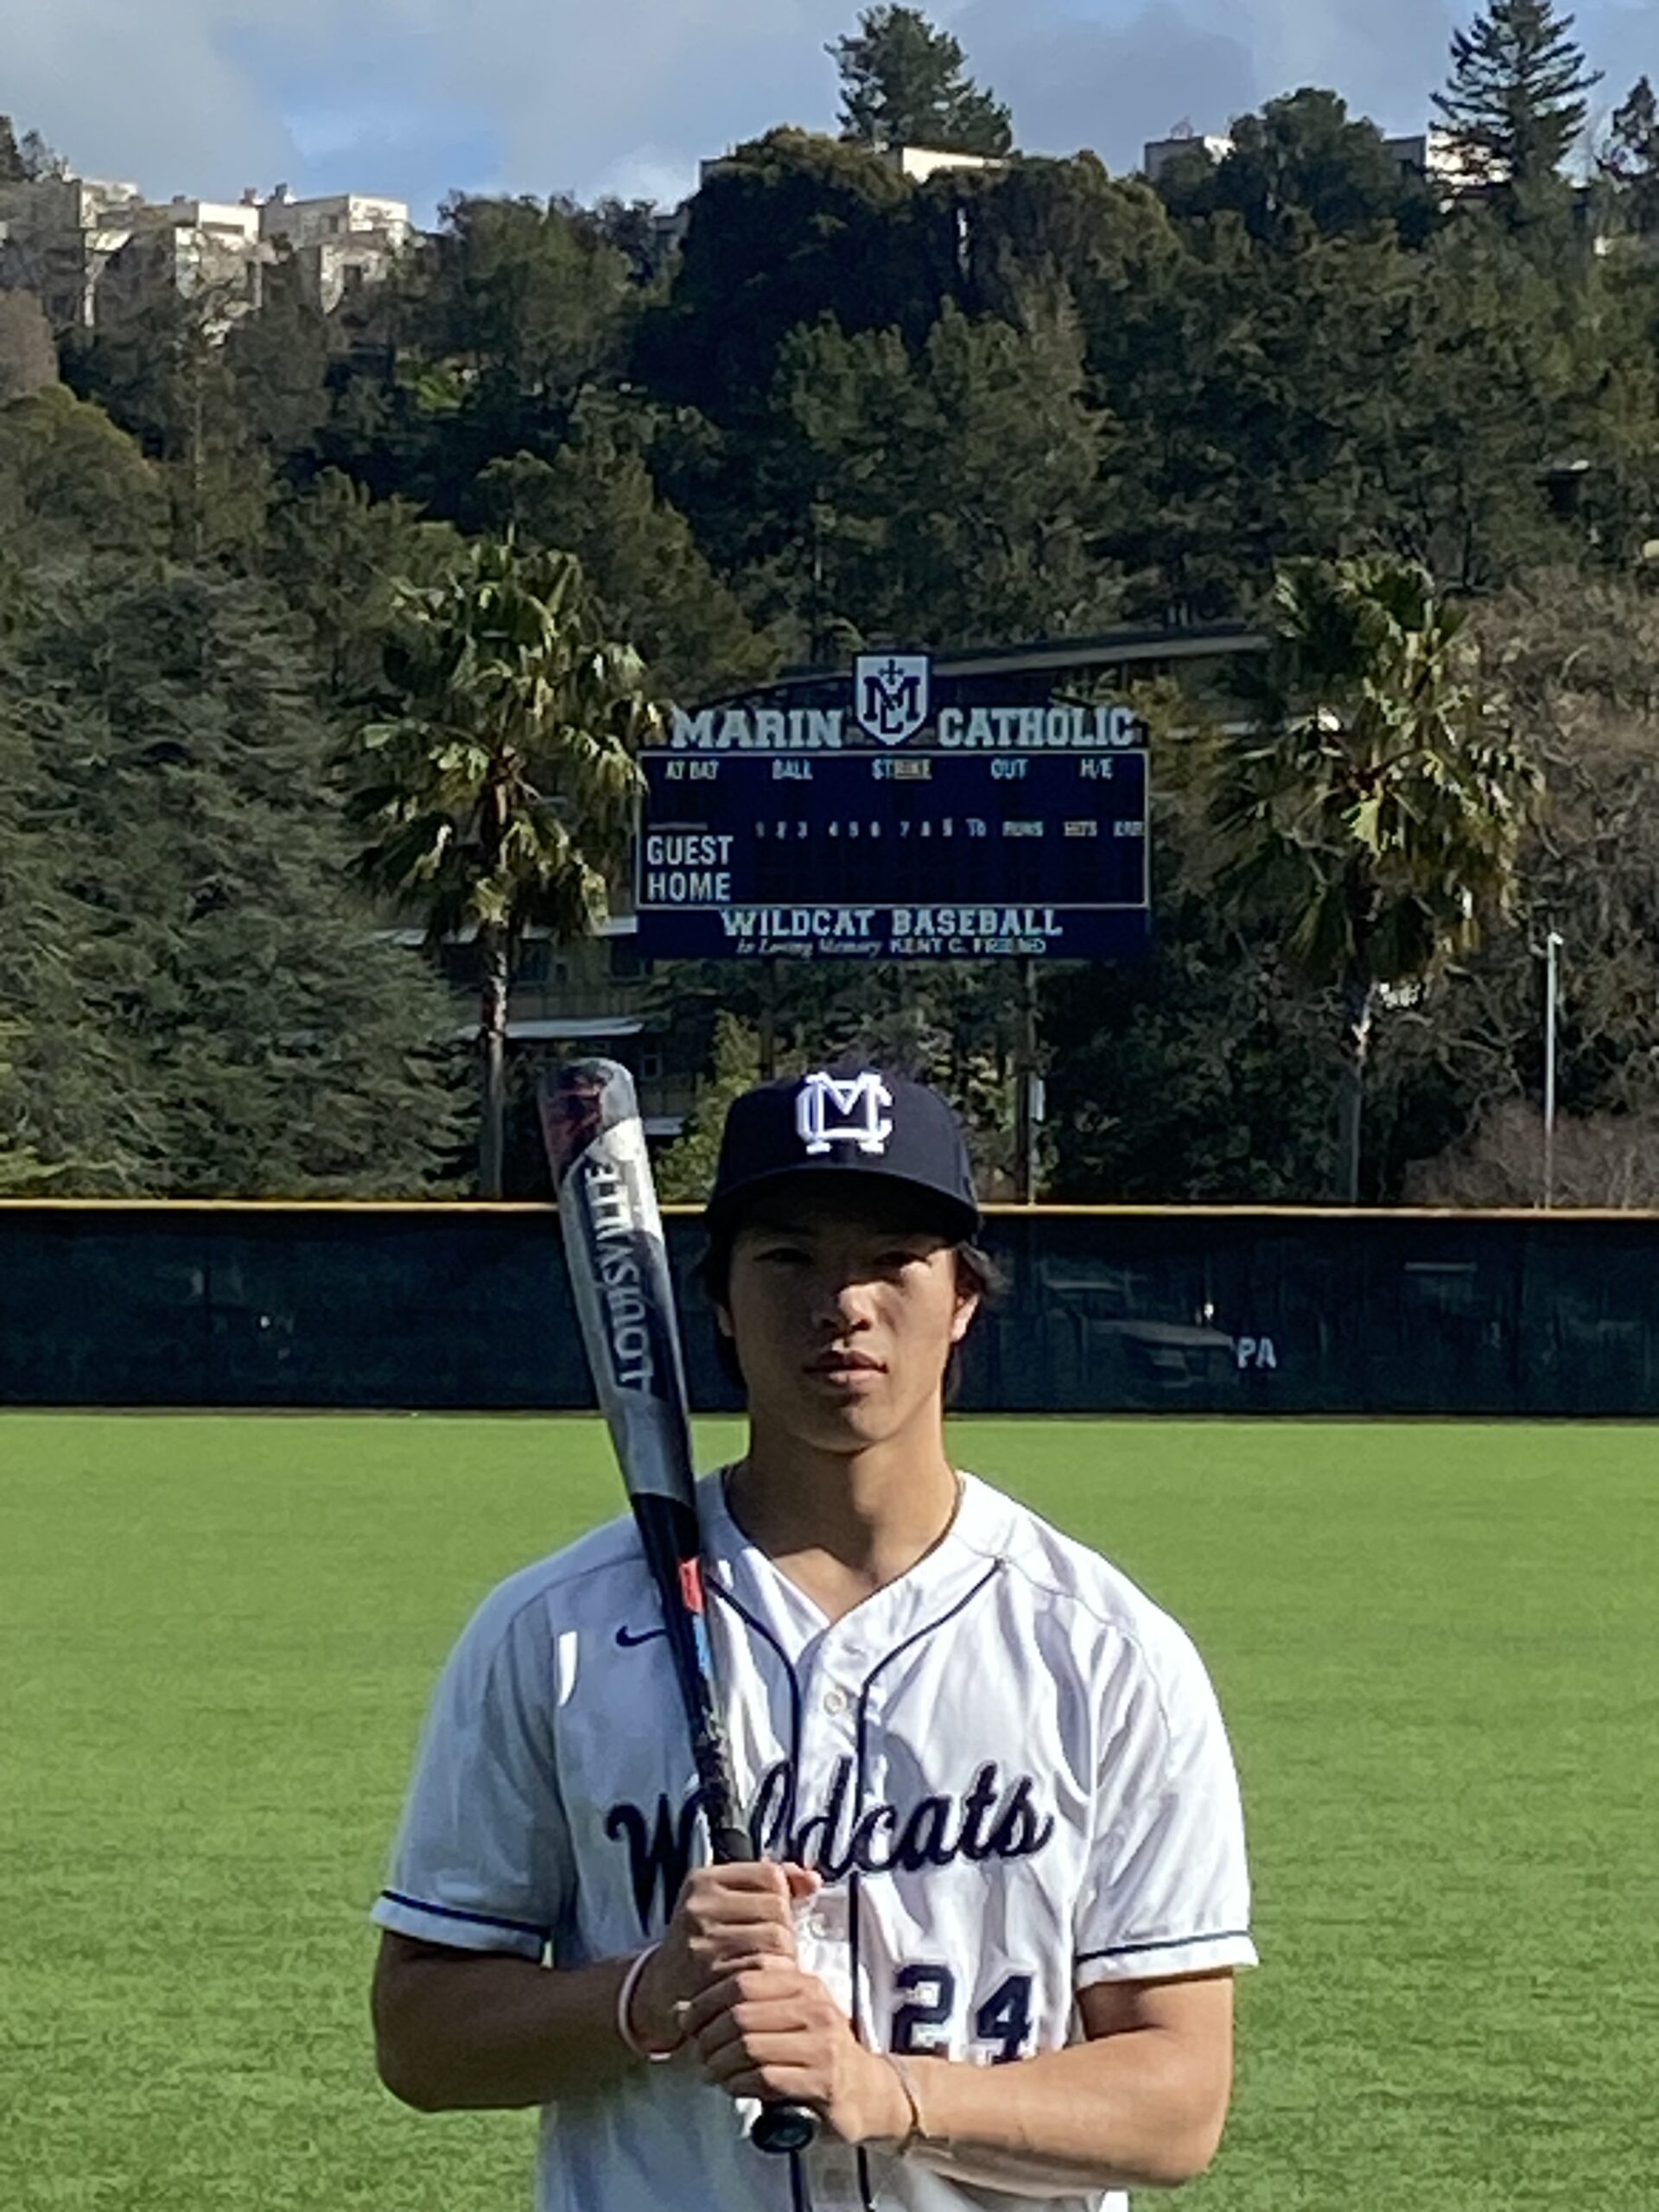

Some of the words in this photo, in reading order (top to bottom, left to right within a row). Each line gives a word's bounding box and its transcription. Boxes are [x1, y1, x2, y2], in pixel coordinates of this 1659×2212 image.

[671, 707, 843, 748] MARIN
[938, 707, 1136, 748] CATHOLIC
[772, 759, 814, 779] BALL
[990, 759, 1028, 779] OUT
[647, 835, 734, 865] GUEST
[647, 872, 731, 901] HOME
[721, 908, 875, 936] WILDCAT
[892, 908, 1063, 936] BASEBALL
[584, 1162, 653, 1383] LOUISVILLE
[1237, 1336, 1277, 1369] PA
[607, 1756, 1055, 1937] Wldcats
[891, 1963, 1034, 2066] 24
